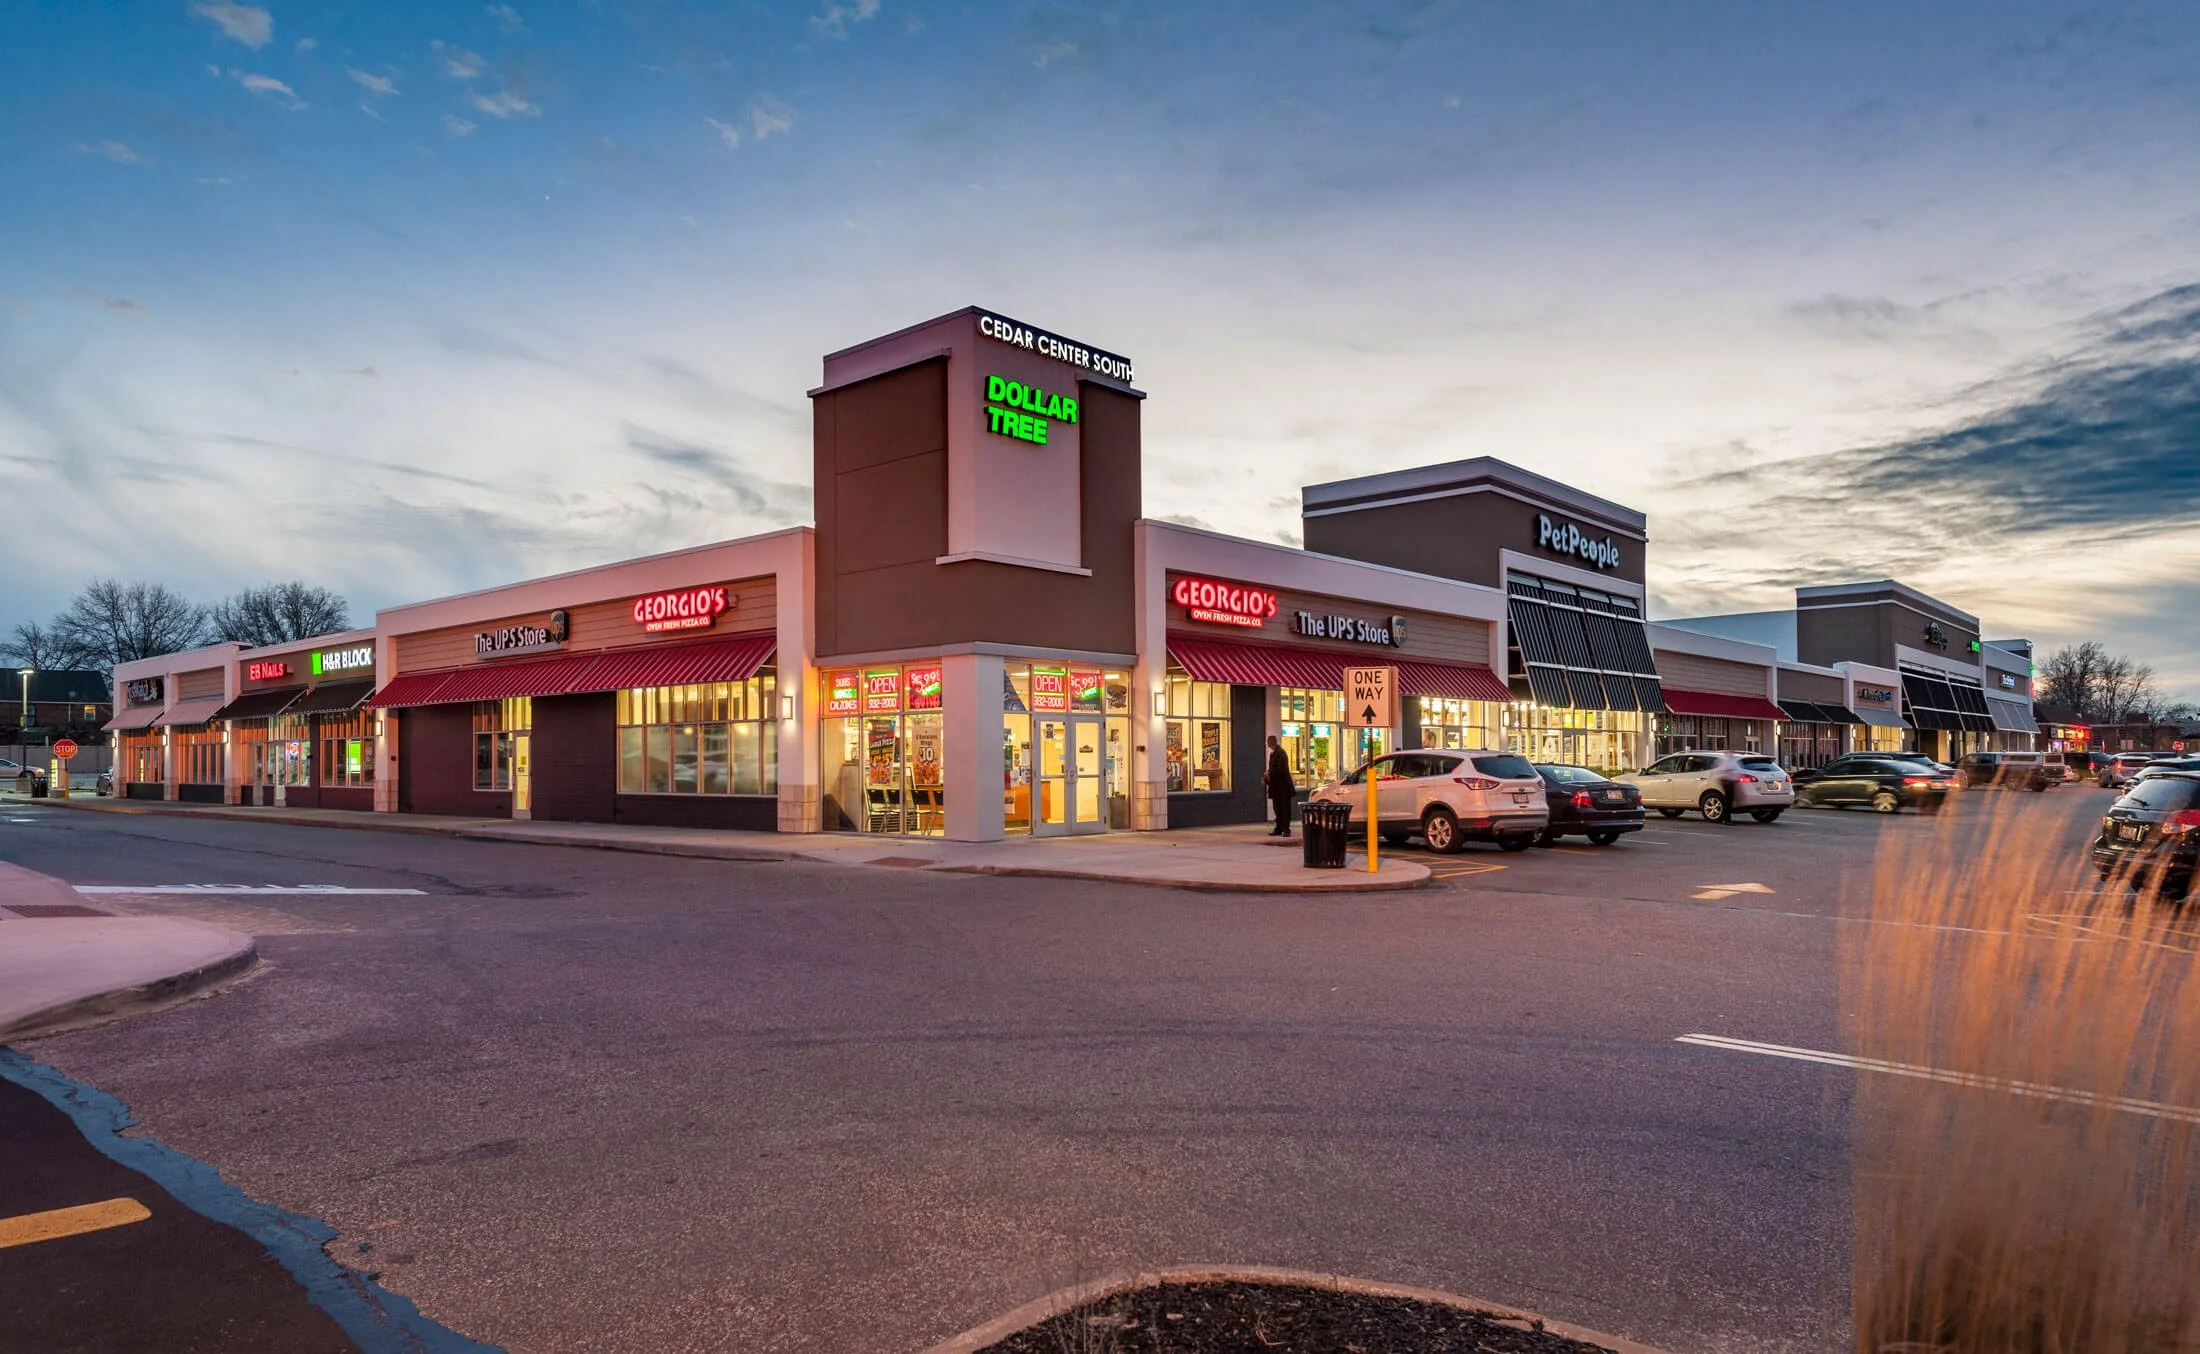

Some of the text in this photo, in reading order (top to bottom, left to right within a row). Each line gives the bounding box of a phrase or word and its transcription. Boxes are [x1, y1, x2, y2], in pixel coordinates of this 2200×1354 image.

[980, 316, 1135, 381] CEDAR CENTER SOUTH
[988, 375, 1078, 423] DOLLAR
[988, 406, 1048, 444] TREE
[1539, 514, 1619, 568] PetPeople
[634, 587, 724, 622] GEORGIO'S
[1175, 579, 1277, 617] GEORGIO'S
[647, 622, 662, 631] OVEN
[663, 620, 680, 630] FRESH
[681, 618, 698, 628] PIZZA
[1193, 609, 1262, 626] OVEN FRESH PIZZA CO.
[1299, 611, 1390, 645] The UPS Store
[473, 626, 547, 653] The UPS Store
[322, 647, 372, 671] H&R BLOCK
[249, 664, 261, 680] EB
[1355, 671, 1382, 684] ONE
[835, 677, 851, 687] SUBS
[870, 677, 896, 693] OPEN
[1035, 675, 1062, 692] OPEN
[1355, 687, 1384, 700] WAY
[868, 697, 897, 709] 932-2000
[55, 745, 76, 754] STOP
